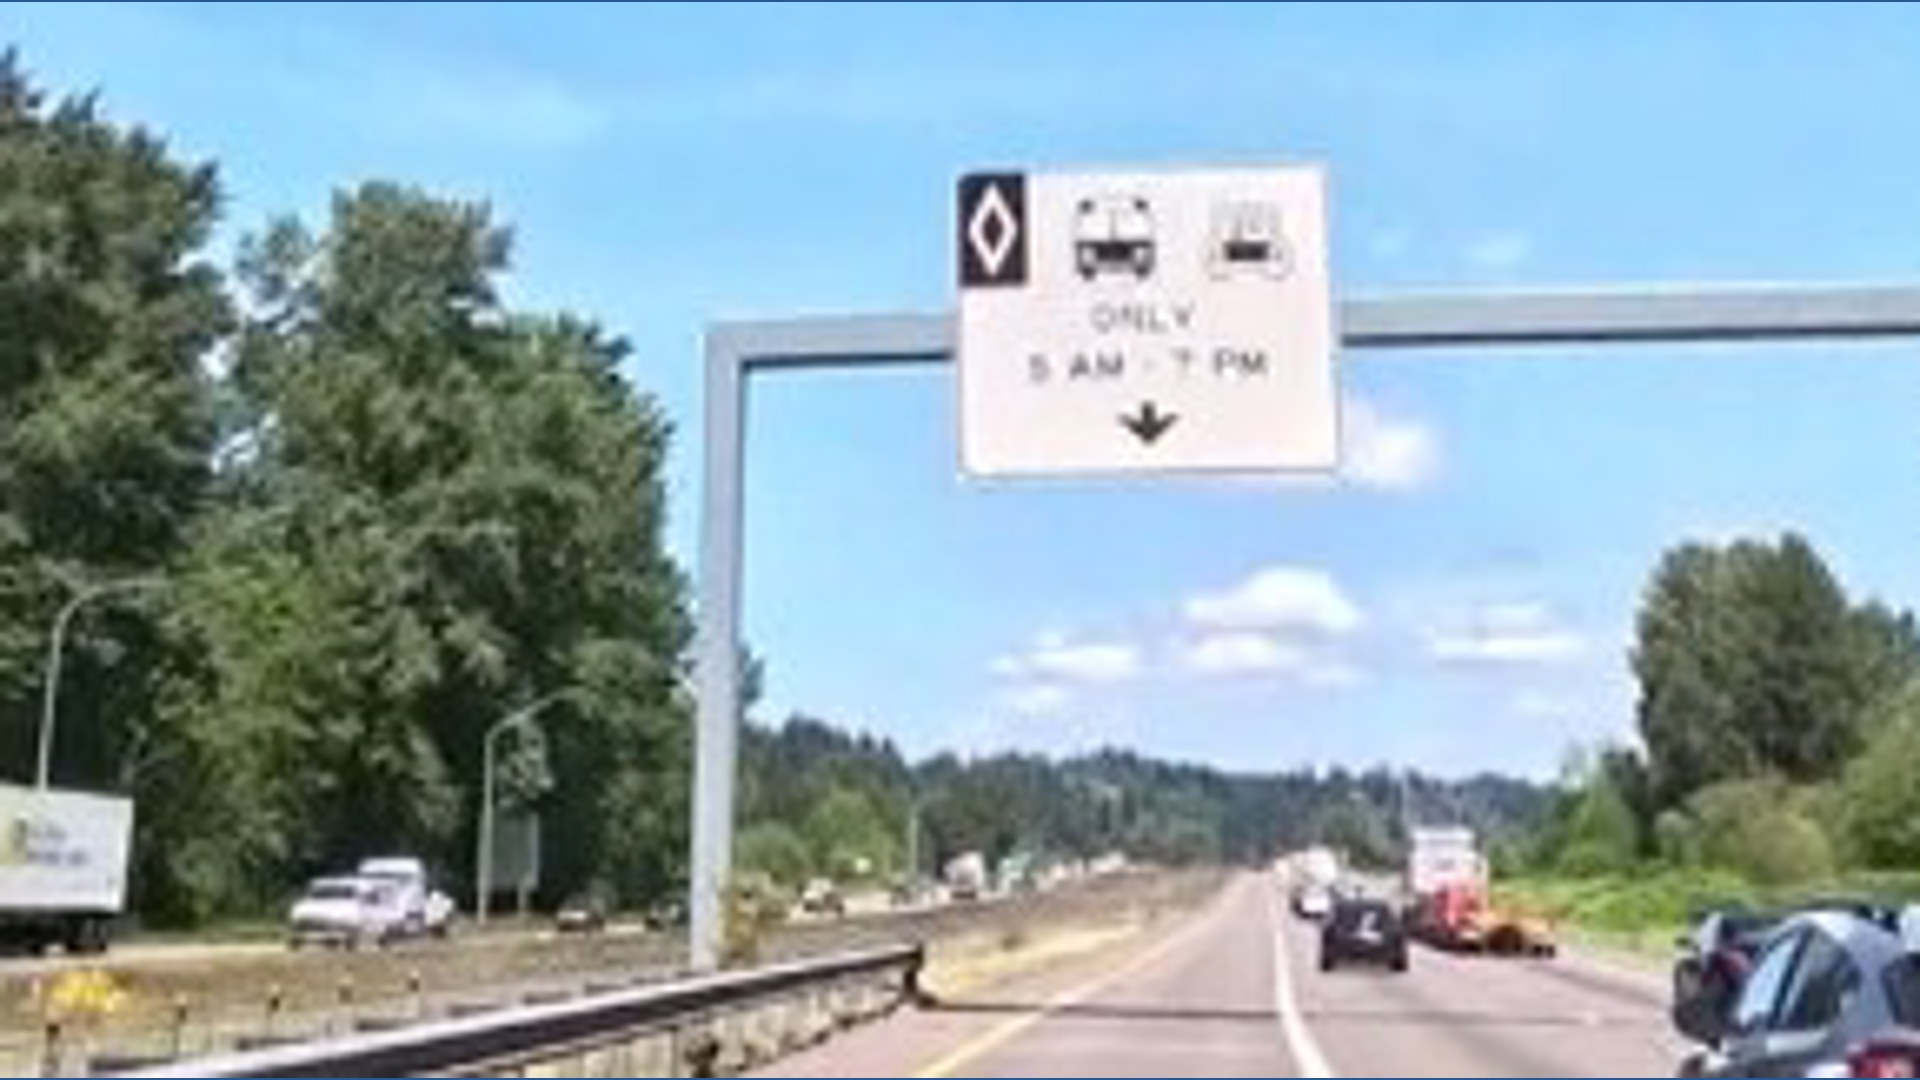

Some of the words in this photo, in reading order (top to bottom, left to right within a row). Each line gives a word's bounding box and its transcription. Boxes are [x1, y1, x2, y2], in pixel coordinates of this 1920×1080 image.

[1090, 301, 1195, 334] ONLY
[1068, 350, 1125, 380] AM
[1213, 346, 1269, 376] PM
